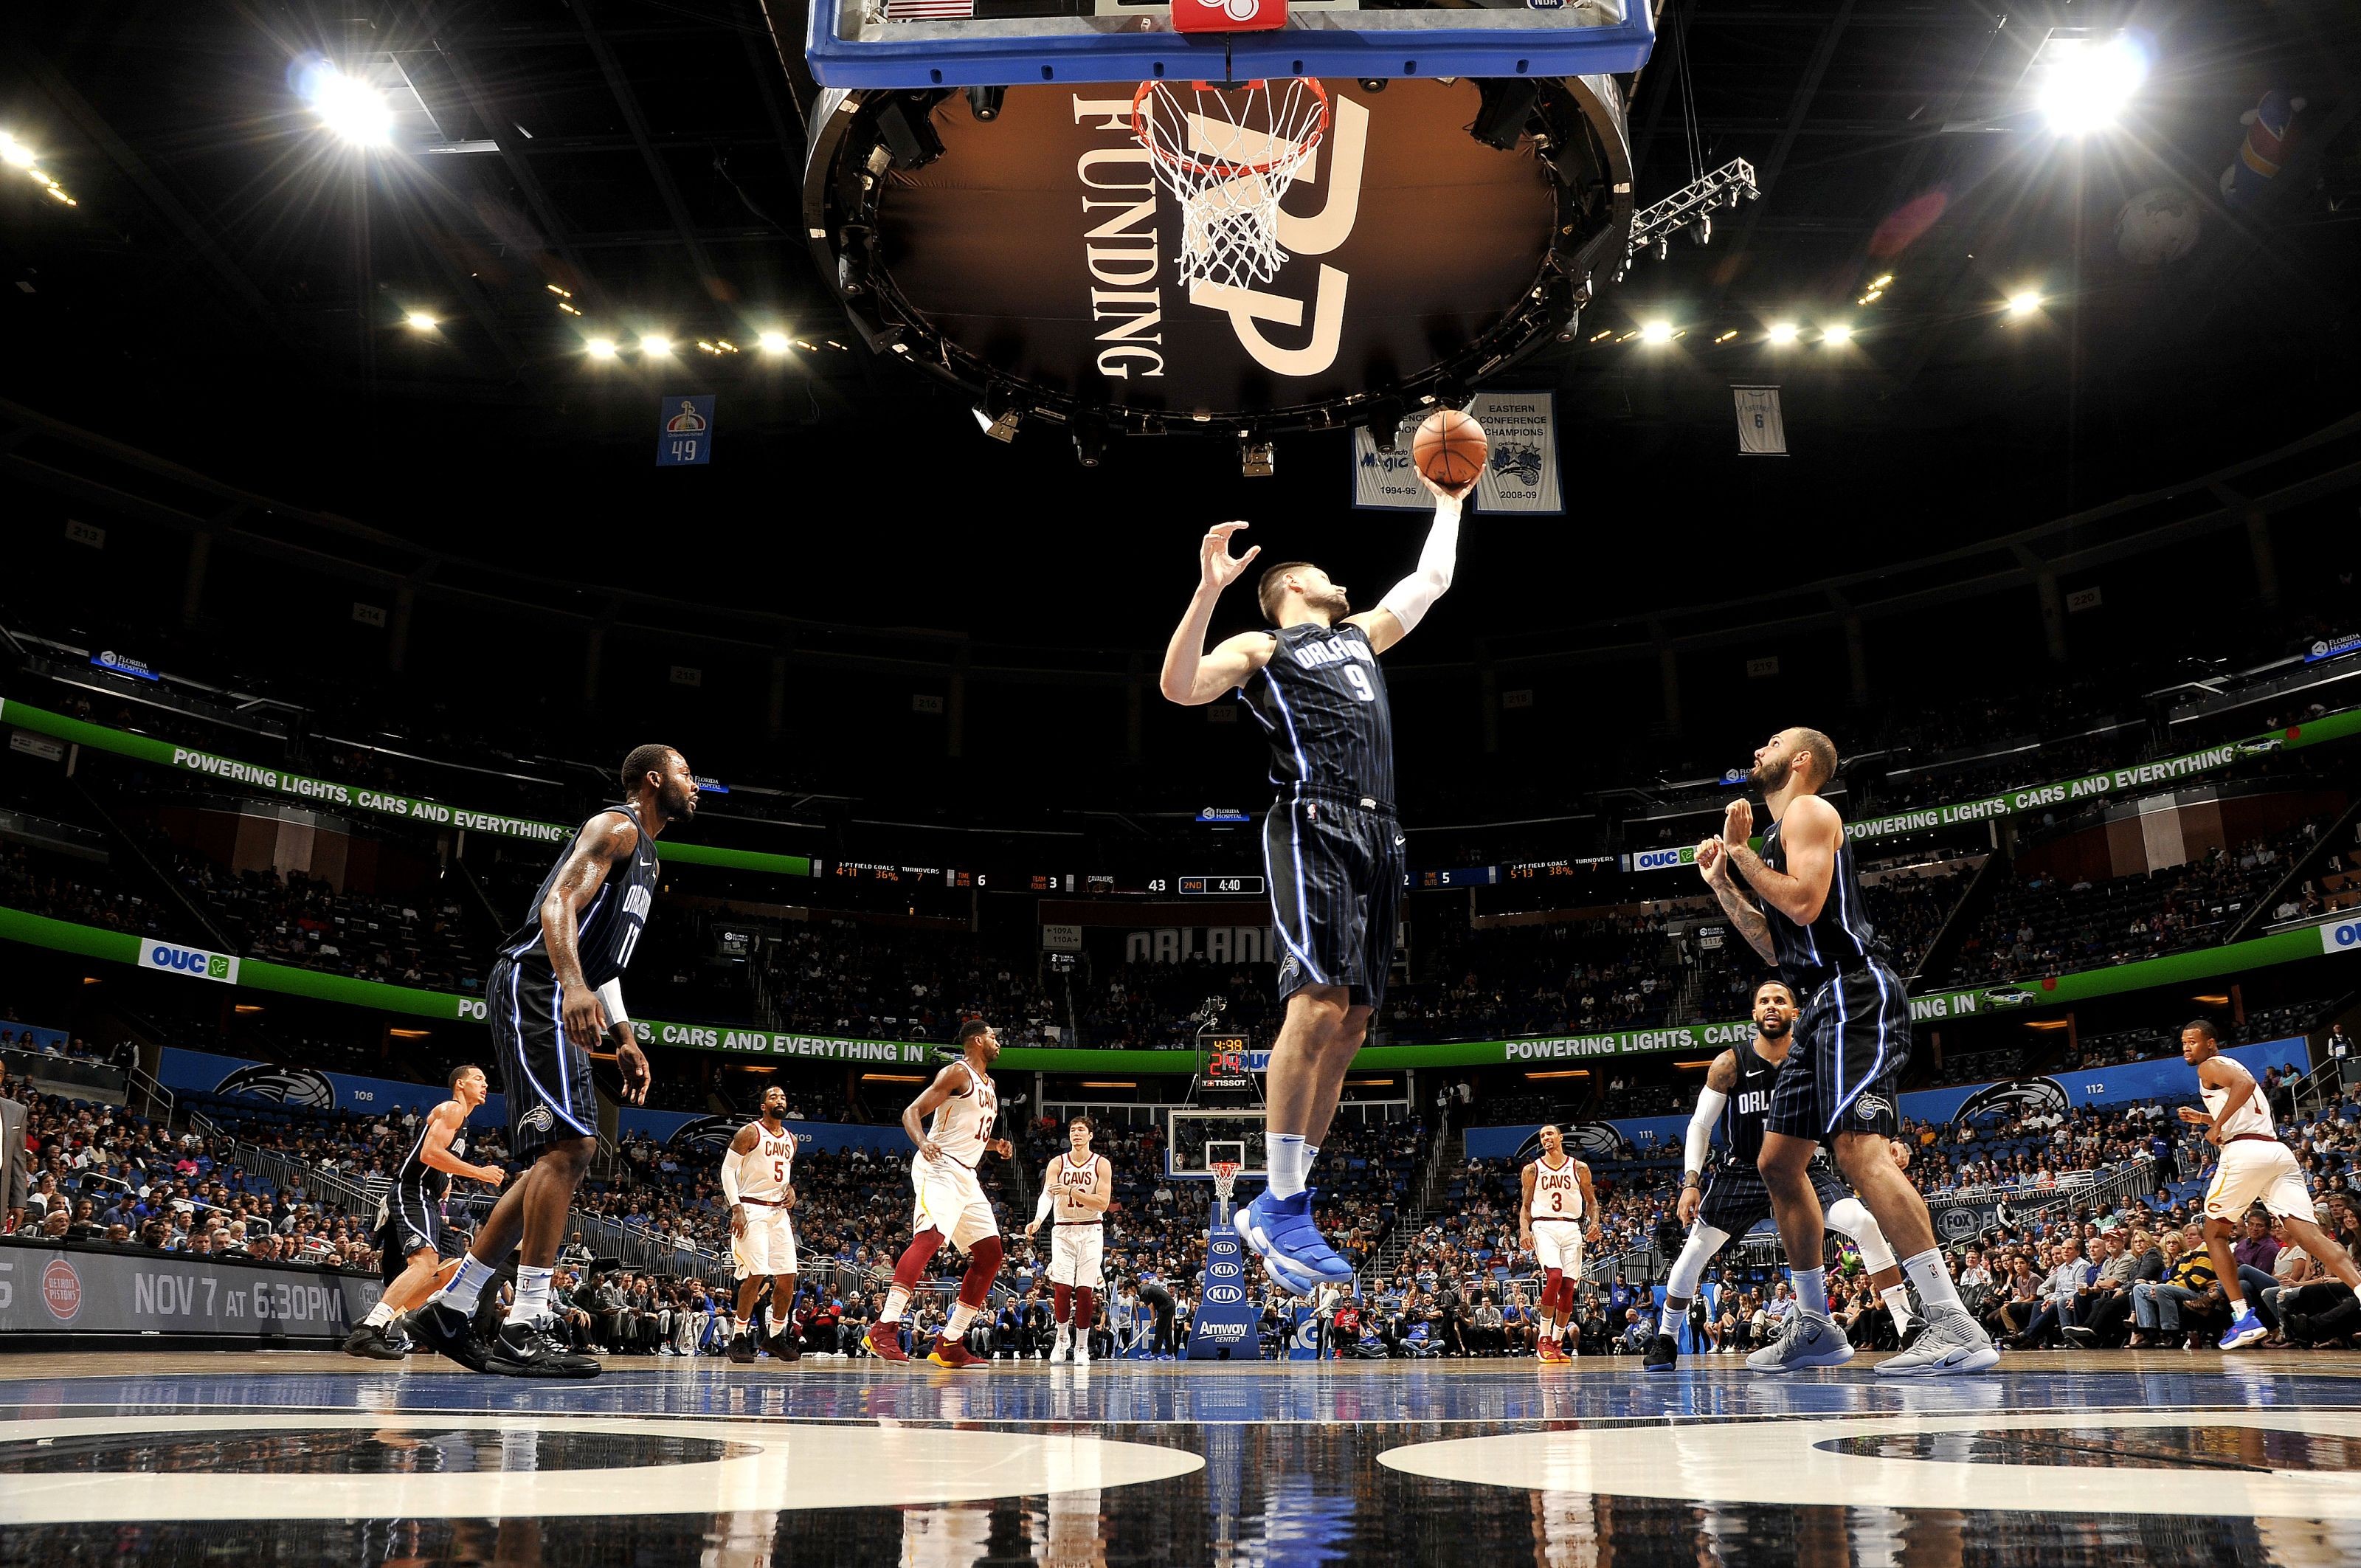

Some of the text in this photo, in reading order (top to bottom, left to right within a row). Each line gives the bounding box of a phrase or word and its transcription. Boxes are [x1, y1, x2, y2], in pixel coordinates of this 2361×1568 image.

[1073, 93, 1164, 380] FUNDING
[1489, 404, 1535, 412] EASTERN
[1479, 416, 1547, 424] CONFERENCE
[1755, 413, 1764, 429] 6
[1484, 428, 1544, 437] CHAMPIONS
[671, 440, 697, 461] 49
[1380, 486, 1417, 495] 1994-95
[1500, 491, 1537, 499] 2008-09
[73, 524, 97, 542] 213
[2073, 593, 2095, 606] 220
[358, 606, 380, 620] 214
[2329, 633, 2360, 646] FLORIDA
[2330, 638, 2361, 653] HOSPITA
[117, 661, 149, 676] HOSPITAL
[118, 655, 148, 669] FLORIDA
[1752, 661, 1773, 672] 219
[1343, 664, 1375, 701] 9
[694, 776, 719, 784] FLORIDA
[173, 748, 563, 841] POWERING LIGHTS, CARS AND EVERYTHING
[1846, 747, 2234, 839] POWERING LIGHTS, CARS AND EVERYTHING
[1574, 856, 1614, 864] TURNOVERS
[1639, 852, 1678, 868] OUC
[836, 868, 923, 882] 4-11 36% 7
[902, 866, 940, 874] TURNOVERS
[1510, 863, 1597, 879] 5-13 38% 7
[978, 875, 986, 885] 6
[1049, 877, 1057, 888] 3
[1088, 875, 1114, 884] CAVALIERS
[1442, 872, 1451, 883] 5
[1148, 880, 1166, 891] 43
[1183, 880, 1240, 891] 2ND 4:40
[1053, 927, 1073, 935] 109A
[616, 921, 640, 969] 17
[152, 946, 207, 973] OUC
[1953, 993, 1976, 1015] IN
[663, 1025, 718, 1047] CARS
[722, 1032, 767, 1051] AND
[772, 1035, 898, 1060] EVERYTHING
[903, 1045, 924, 1063] IN
[1506, 1023, 1759, 1060] POWERING LIGHTS, CARS
[1209, 1053, 1240, 1075] 24
[354, 1090, 373, 1101] 108
[2085, 1083, 2104, 1094] 112
[978, 1088, 998, 1114] CAVS
[2253, 1092, 2263, 1115] 1
[974, 1115, 993, 1143] 13
[1639, 1130, 1653, 1139] 111
[765, 1141, 791, 1159] CAVS
[774, 1161, 784, 1182] 5
[1063, 1171, 1092, 1185] CAVS
[1541, 1175, 1571, 1191] CAVS
[1552, 1192, 1562, 1212] 3
[1946, 1213, 1970, 1228] FOX
[1216, 1244, 1233, 1252] KIA
[1214, 1265, 1234, 1274] KIA
[48, 1277, 75, 1290] DETROIT
[49, 1289, 76, 1301] PISTONS
[135, 1273, 342, 1322] NOV 7 AT 6:30PM
[1212, 1288, 1236, 1299] KIA
[1199, 1321, 1248, 1337] Amway
